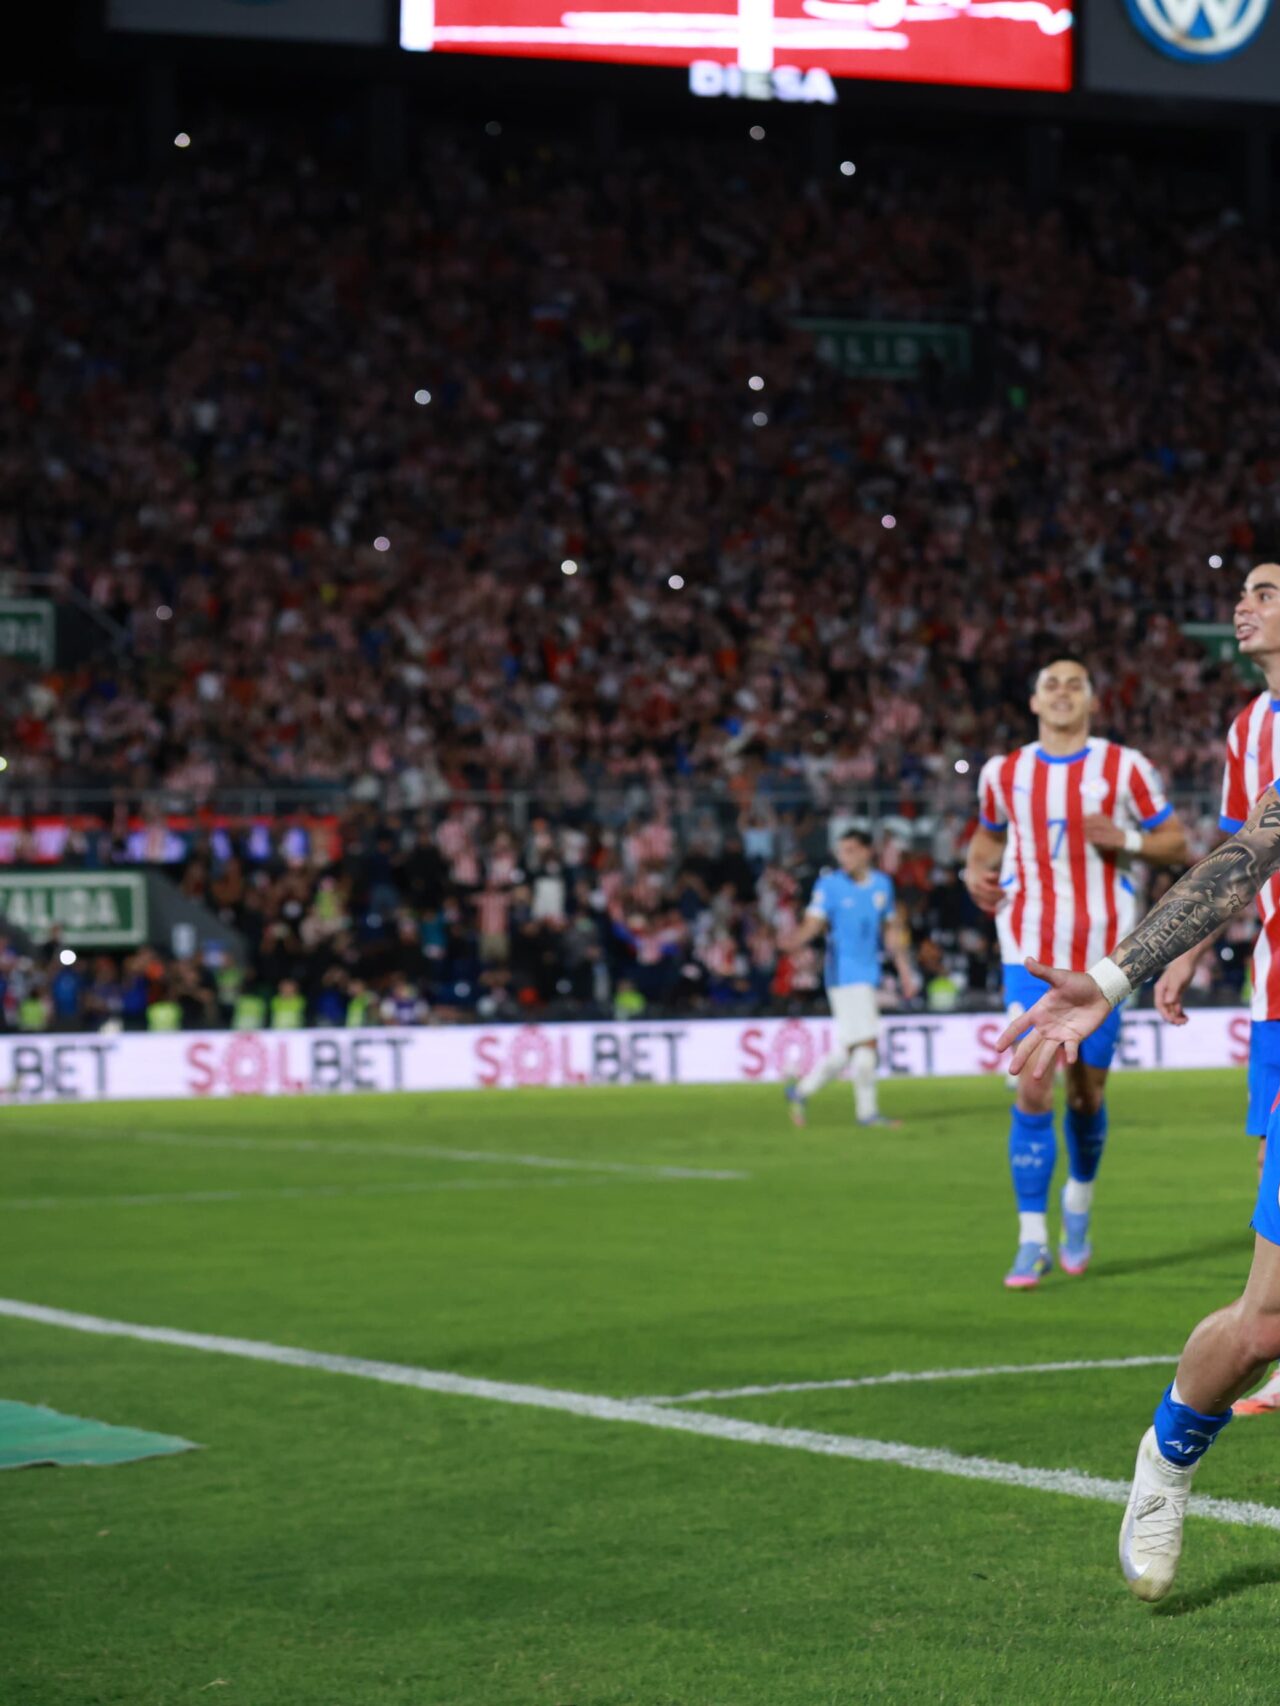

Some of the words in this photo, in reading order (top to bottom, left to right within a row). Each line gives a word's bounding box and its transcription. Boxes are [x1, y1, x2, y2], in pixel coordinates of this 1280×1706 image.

[689, 60, 837, 105] DIESA
[1047, 819, 1068, 860] 7
[2, 889, 121, 927] ALIDA
[11, 1045, 119, 1093] BET
[186, 1032, 413, 1094] SOLBET
[474, 1024, 686, 1085] SOLBET
